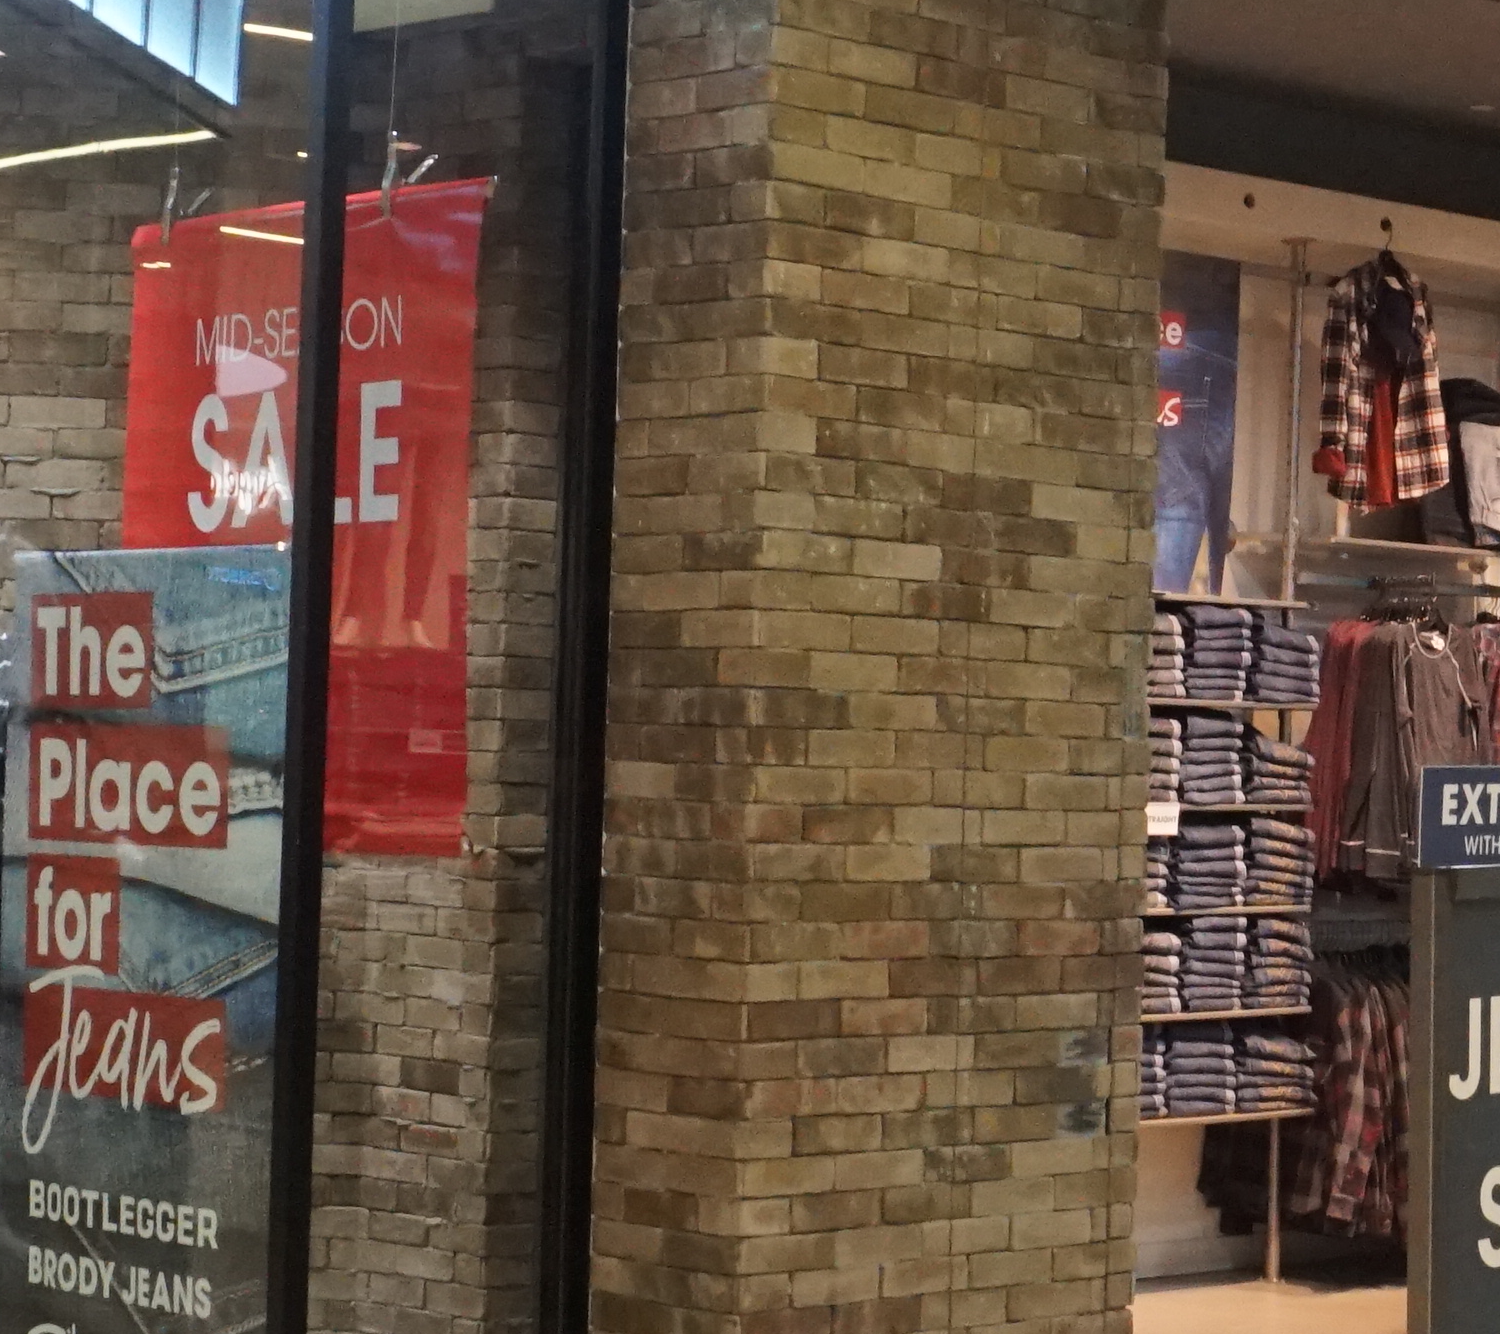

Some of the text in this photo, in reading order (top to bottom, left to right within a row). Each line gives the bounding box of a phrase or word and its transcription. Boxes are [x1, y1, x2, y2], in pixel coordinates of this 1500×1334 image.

[196, 295, 403, 366] MID-SEON
[187, 379, 402, 534] SAE
[35, 605, 146, 699] The
[35, 736, 222, 836] Place
[33, 866, 112, 962] for
[21, 966, 222, 1154] Jeans
[29, 1179, 219, 1250] BOOTLEGGER
[28, 1245, 213, 1319] BRODY JEANS
